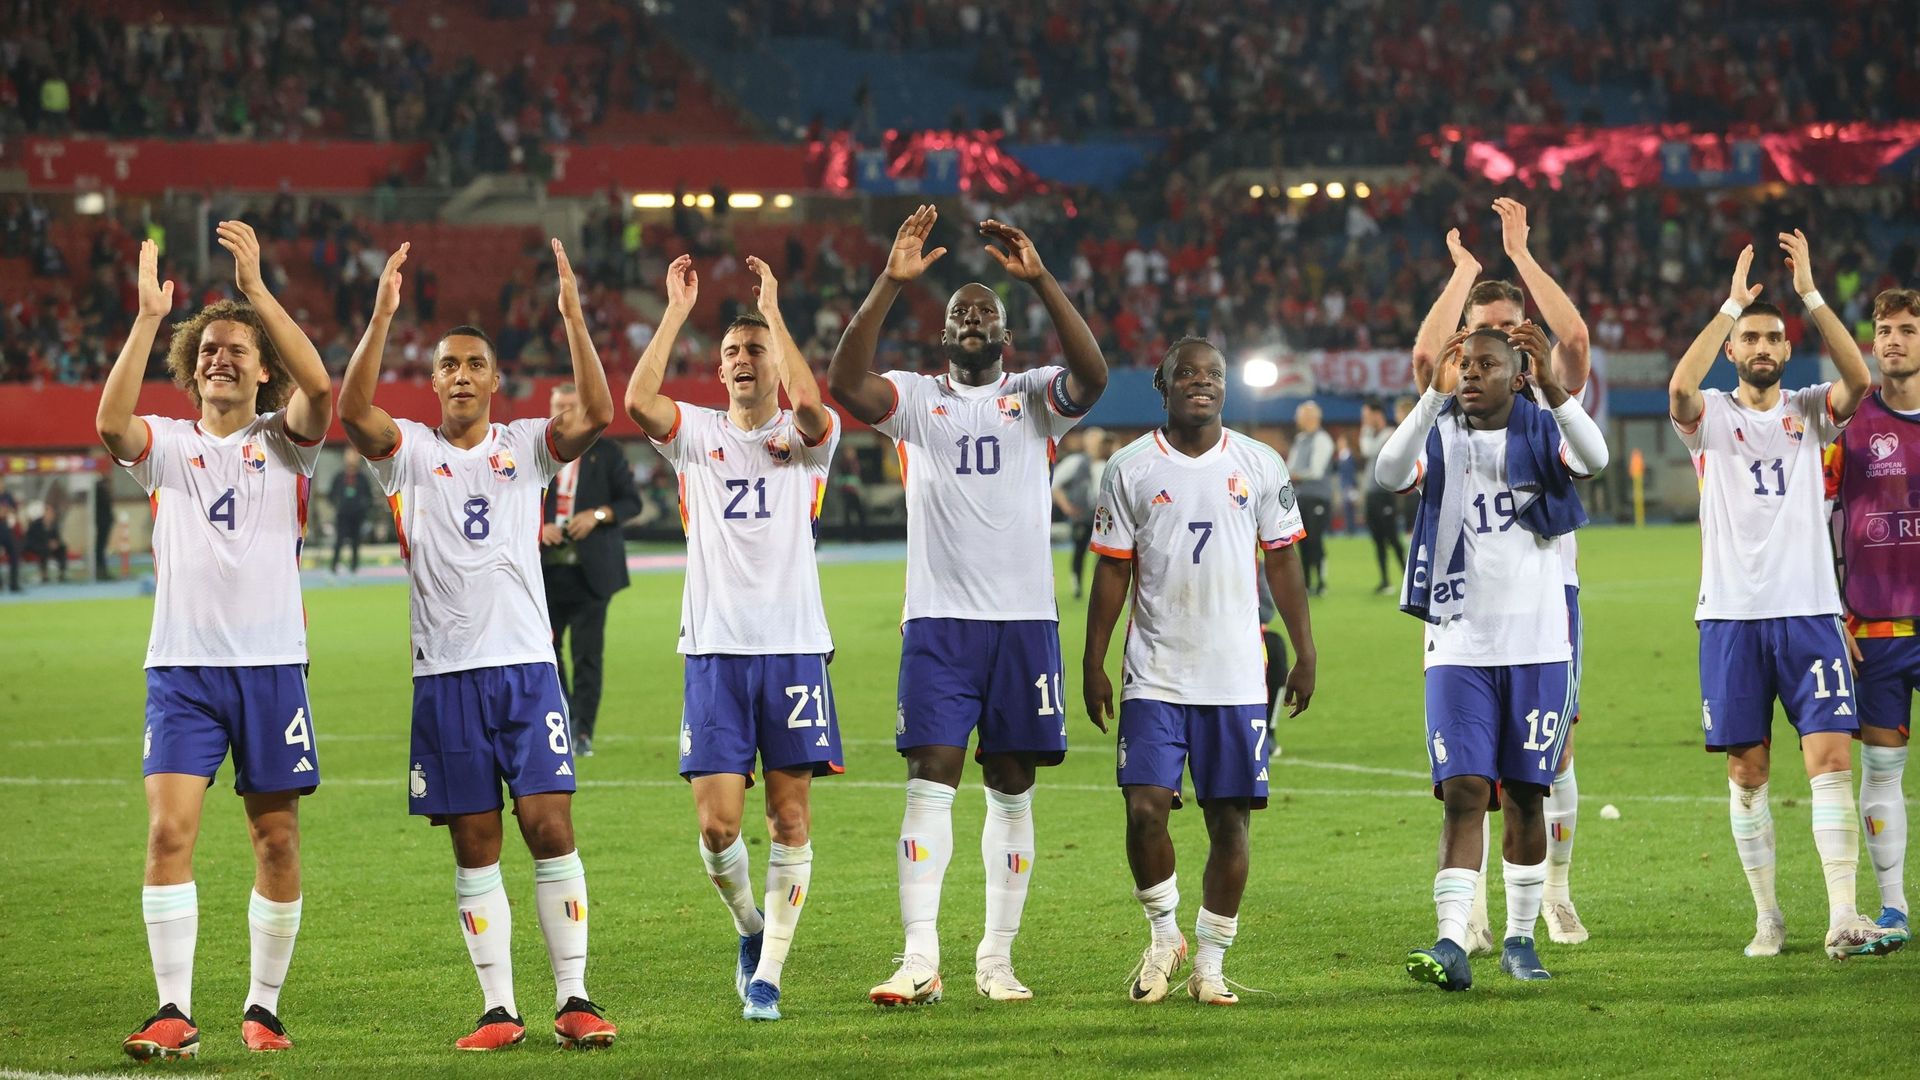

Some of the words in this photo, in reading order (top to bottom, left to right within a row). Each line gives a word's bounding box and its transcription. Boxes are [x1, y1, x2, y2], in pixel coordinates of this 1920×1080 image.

[956, 435, 1000, 475] 10
[1866, 468, 1906, 478] QUALIFIERS
[1868, 462, 1902, 471] EUROPEAN
[724, 478, 770, 519] 21
[1750, 459, 1786, 496] 11
[210, 488, 235, 530] 4
[464, 498, 490, 540] 8
[1473, 491, 1518, 533] 19
[1188, 521, 1213, 564] 7
[1810, 658, 1849, 698] 11
[785, 685, 827, 728] 21
[285, 707, 310, 751] 4
[545, 711, 568, 754] 8
[1251, 719, 1267, 761] 7
[1523, 709, 1558, 751] 19
